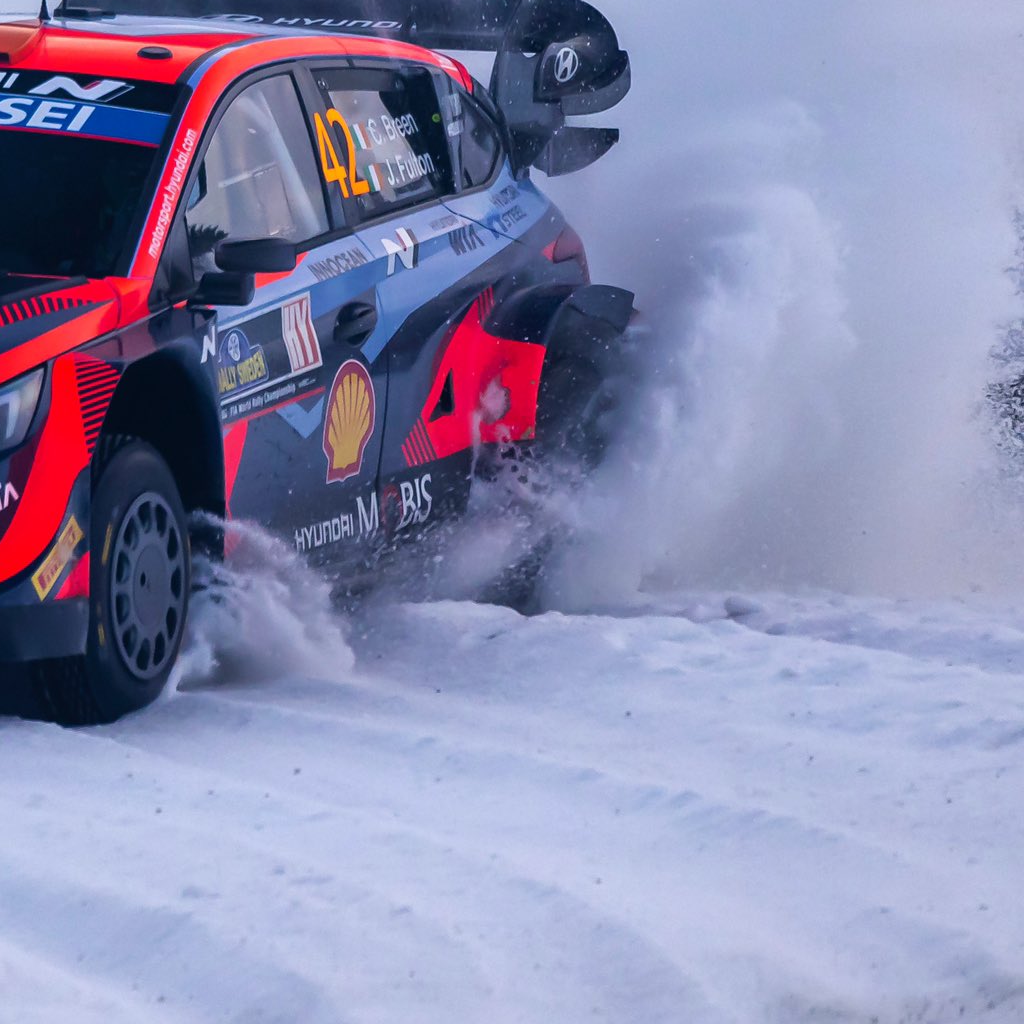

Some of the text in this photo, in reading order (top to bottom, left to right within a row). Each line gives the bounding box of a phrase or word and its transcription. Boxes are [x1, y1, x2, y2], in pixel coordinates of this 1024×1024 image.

[313, 107, 370, 199] 42
[367, 112, 420, 145] C. Breen
[148, 128, 197, 259] motorsport.hyundai.com
[385, 151, 436, 187] J. Fulton
[307, 246, 369, 282] INNOCEAN
[294, 473, 433, 552] HYUNDAI MOBIS
